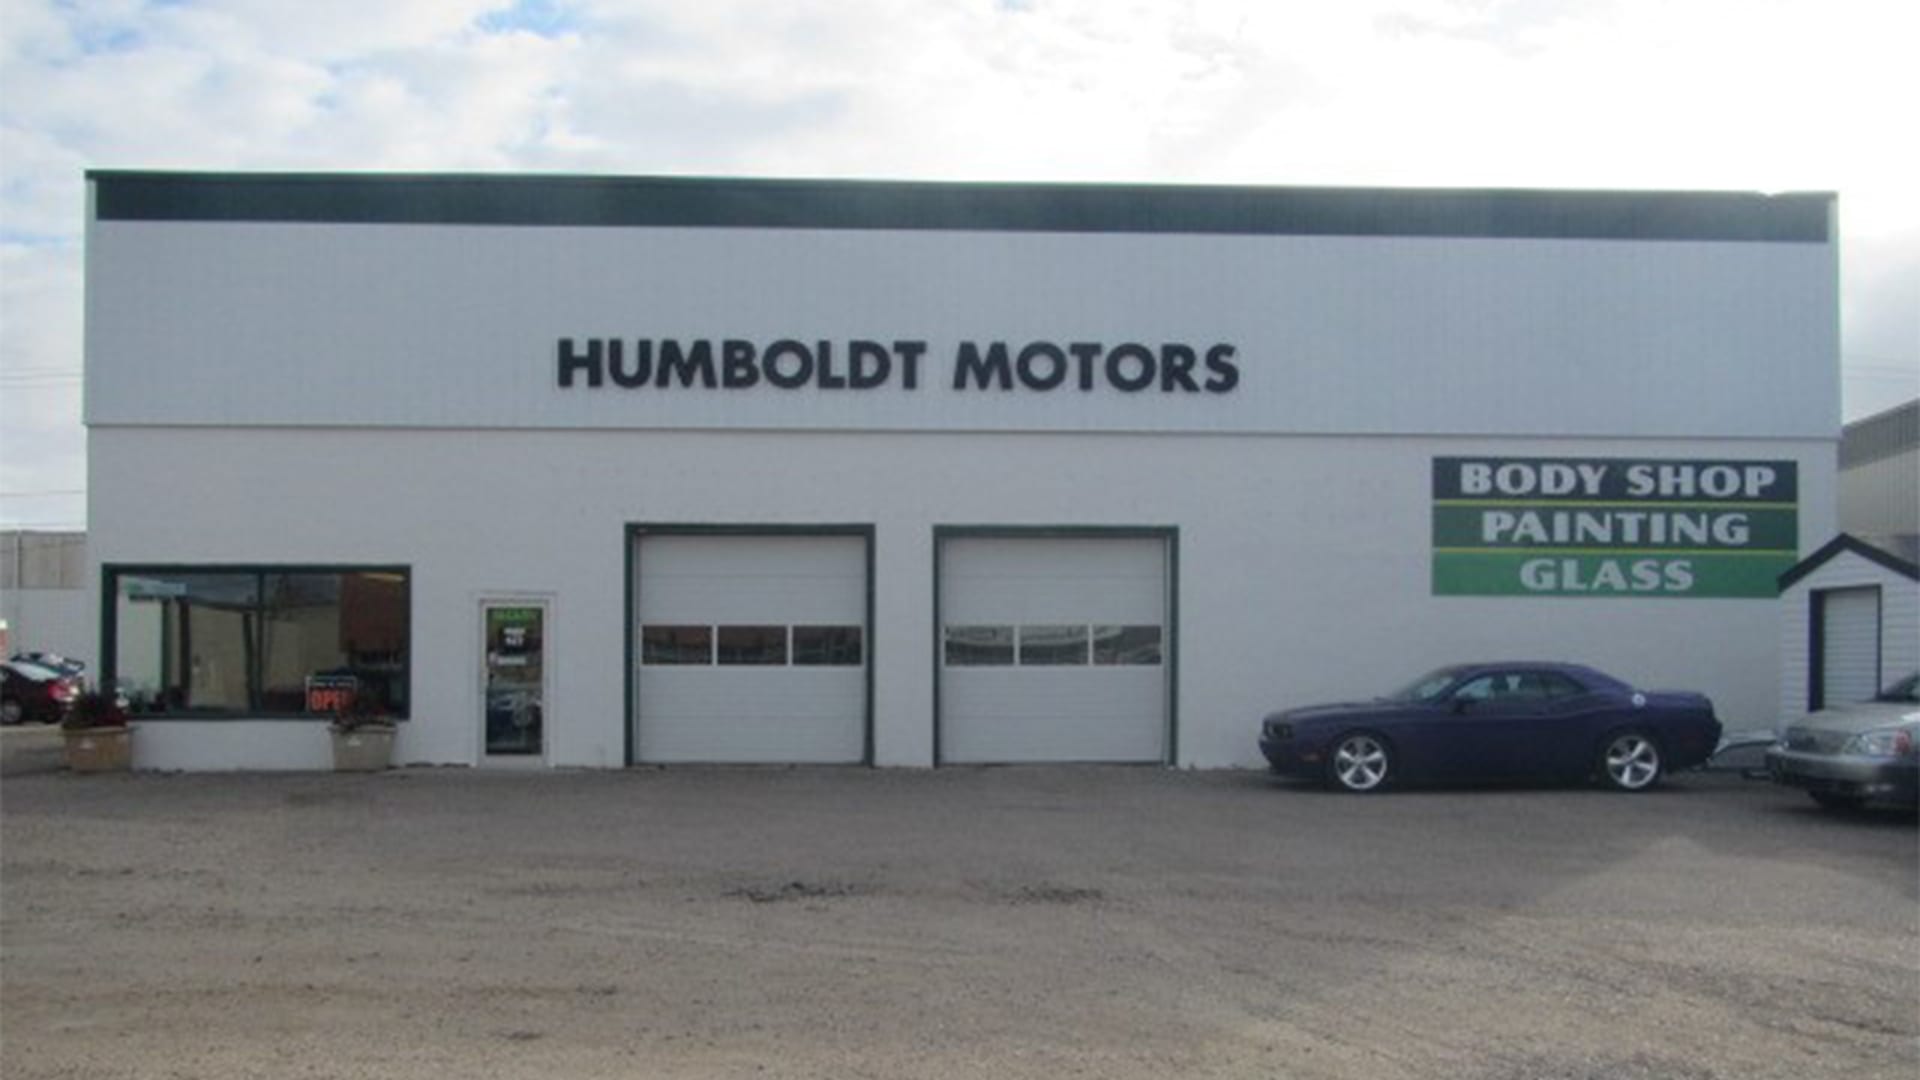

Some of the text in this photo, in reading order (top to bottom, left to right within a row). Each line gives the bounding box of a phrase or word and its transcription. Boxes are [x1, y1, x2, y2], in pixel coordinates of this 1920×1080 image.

[557, 338, 1240, 393] HUMBOLDT MOTORS
[1460, 463, 1776, 496] BODY SHOP
[1482, 511, 1751, 544] PAINTING
[1519, 559, 1694, 590] GLASS
[311, 689, 351, 711] OPE
